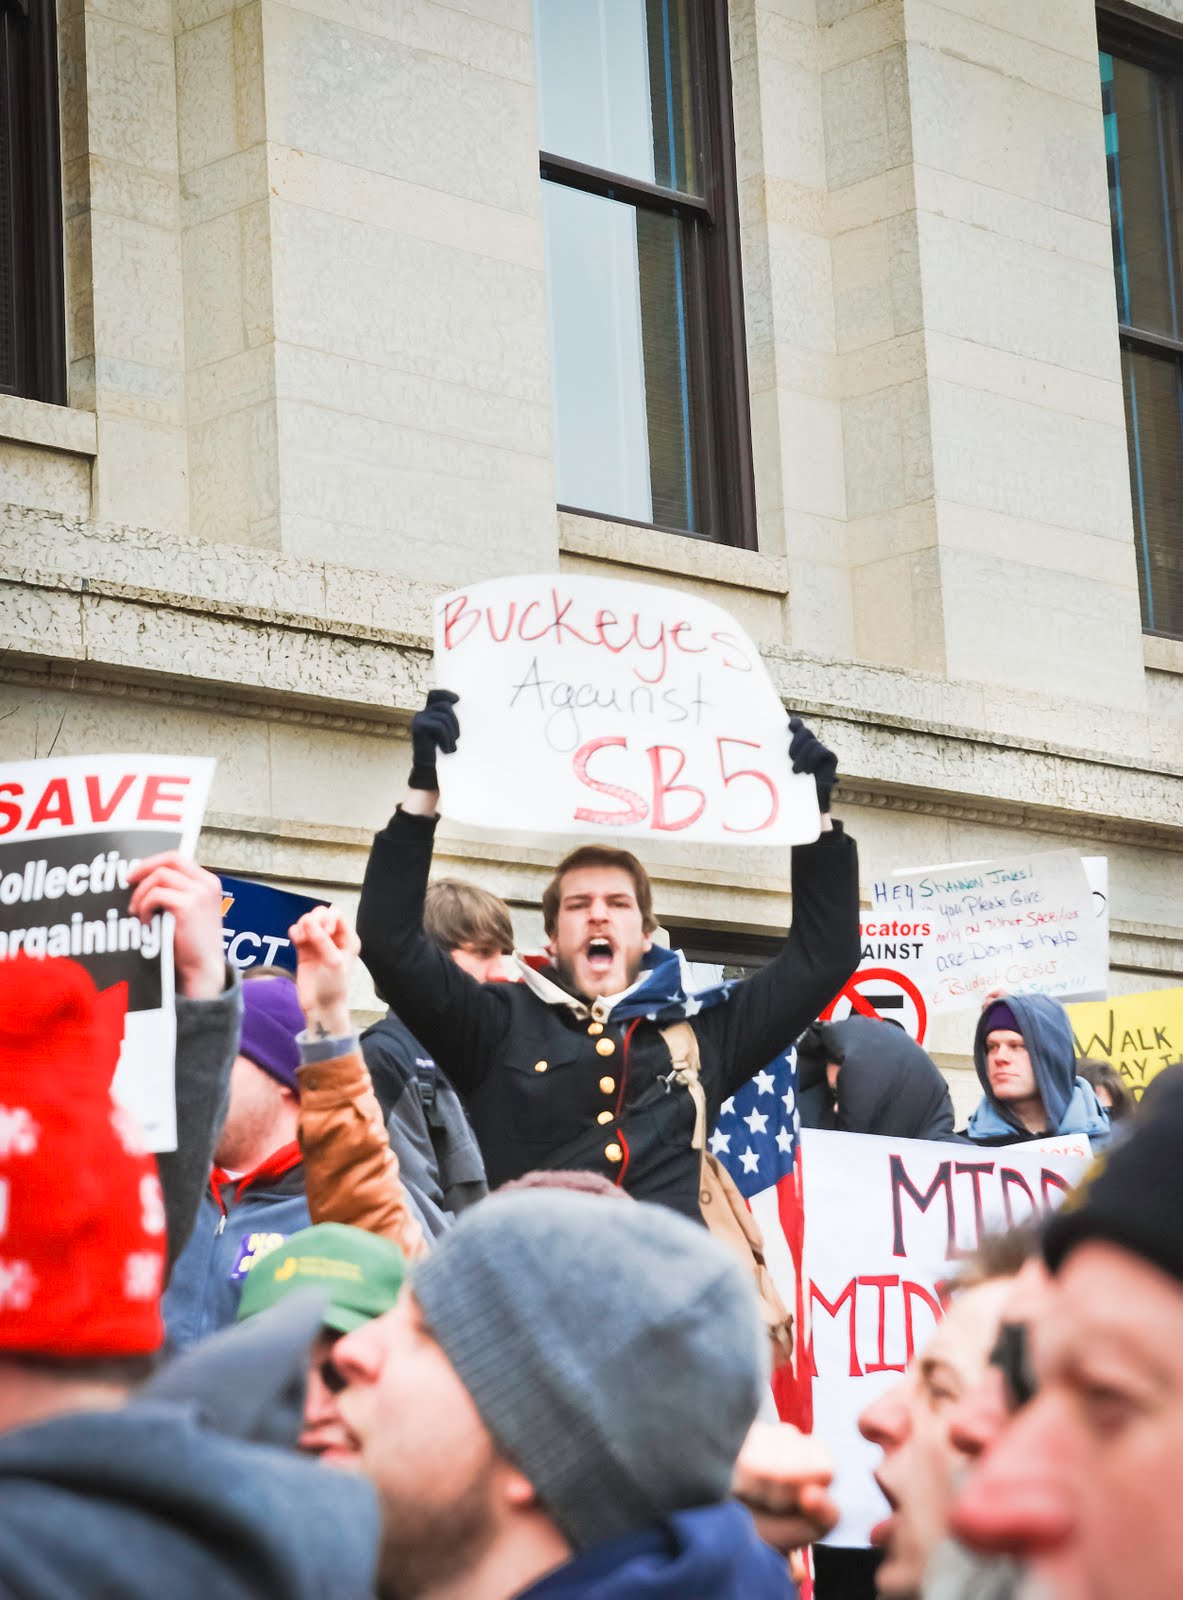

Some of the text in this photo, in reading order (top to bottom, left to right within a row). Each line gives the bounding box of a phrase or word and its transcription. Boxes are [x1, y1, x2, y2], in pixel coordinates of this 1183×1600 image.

[509, 655, 713, 753] Against
[0, 773, 192, 836] SAVE
[571, 734, 780, 834] SB5
[0, 850, 142, 906] ollectiv
[861, 943, 924, 960] AINST
[1073, 1008, 1173, 1059] WALK
[1119, 1058, 1148, 1081] AY
[809, 1274, 953, 1378] MID
